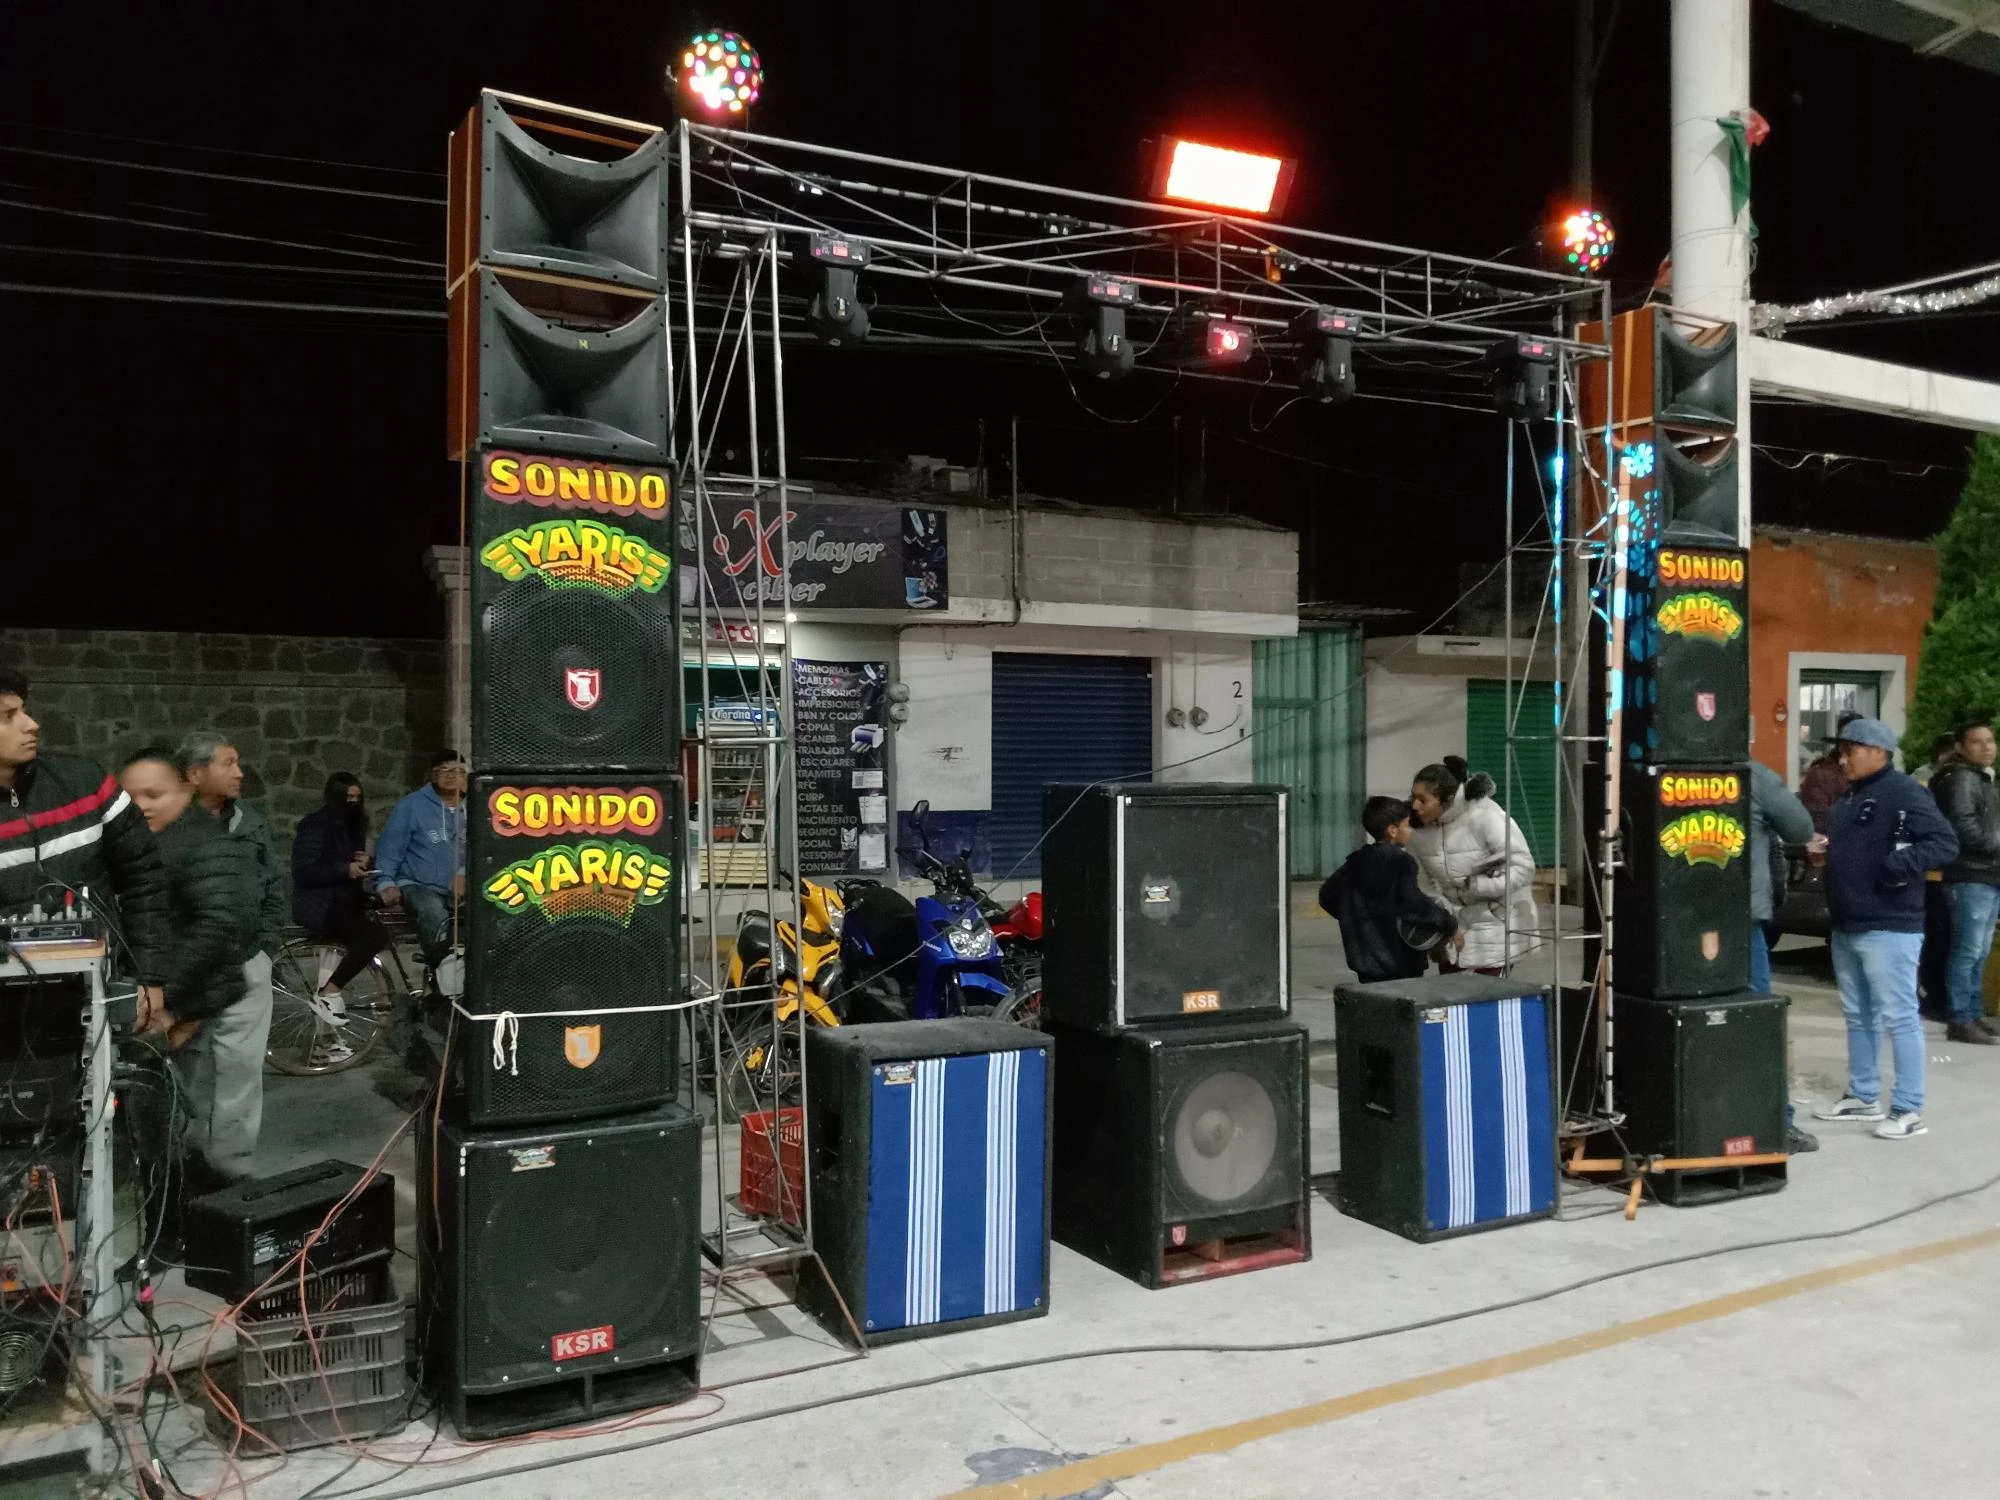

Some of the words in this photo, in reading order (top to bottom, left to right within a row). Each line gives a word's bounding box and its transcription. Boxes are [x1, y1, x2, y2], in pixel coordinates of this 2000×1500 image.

[490, 458, 667, 510] SONIDO
[511, 526, 647, 576] YARIS
[1659, 551, 1744, 583] SONIDO
[742, 576, 826, 602] ciber
[1667, 598, 1730, 627] YARIS
[1232, 681, 1243, 698] 2
[798, 712, 817, 720] B&N
[820, 712, 827, 720] Y
[829, 712, 864, 720] COLOR
[800, 758, 856, 767] ESCOLARES
[799, 781, 817, 789] RFC
[1662, 776, 1739, 801] SONIDO
[799, 793, 824, 801] CURP
[495, 792, 656, 829] SONIDO
[799, 805, 829, 813] ACTAS
[831, 805, 843, 813] DE
[799, 816, 857, 824] NACIMIENTO
[799, 828, 837, 836] SEGURO
[1673, 815, 1735, 848] YARIS
[799, 840, 832, 848] SOCIAL
[515, 848, 646, 894] YARIS
[799, 863, 847, 871] CONTABLE
[1187, 994, 1218, 1009] KSR
[1727, 1139, 1750, 1154] KSR
[556, 1331, 608, 1357] KSR
